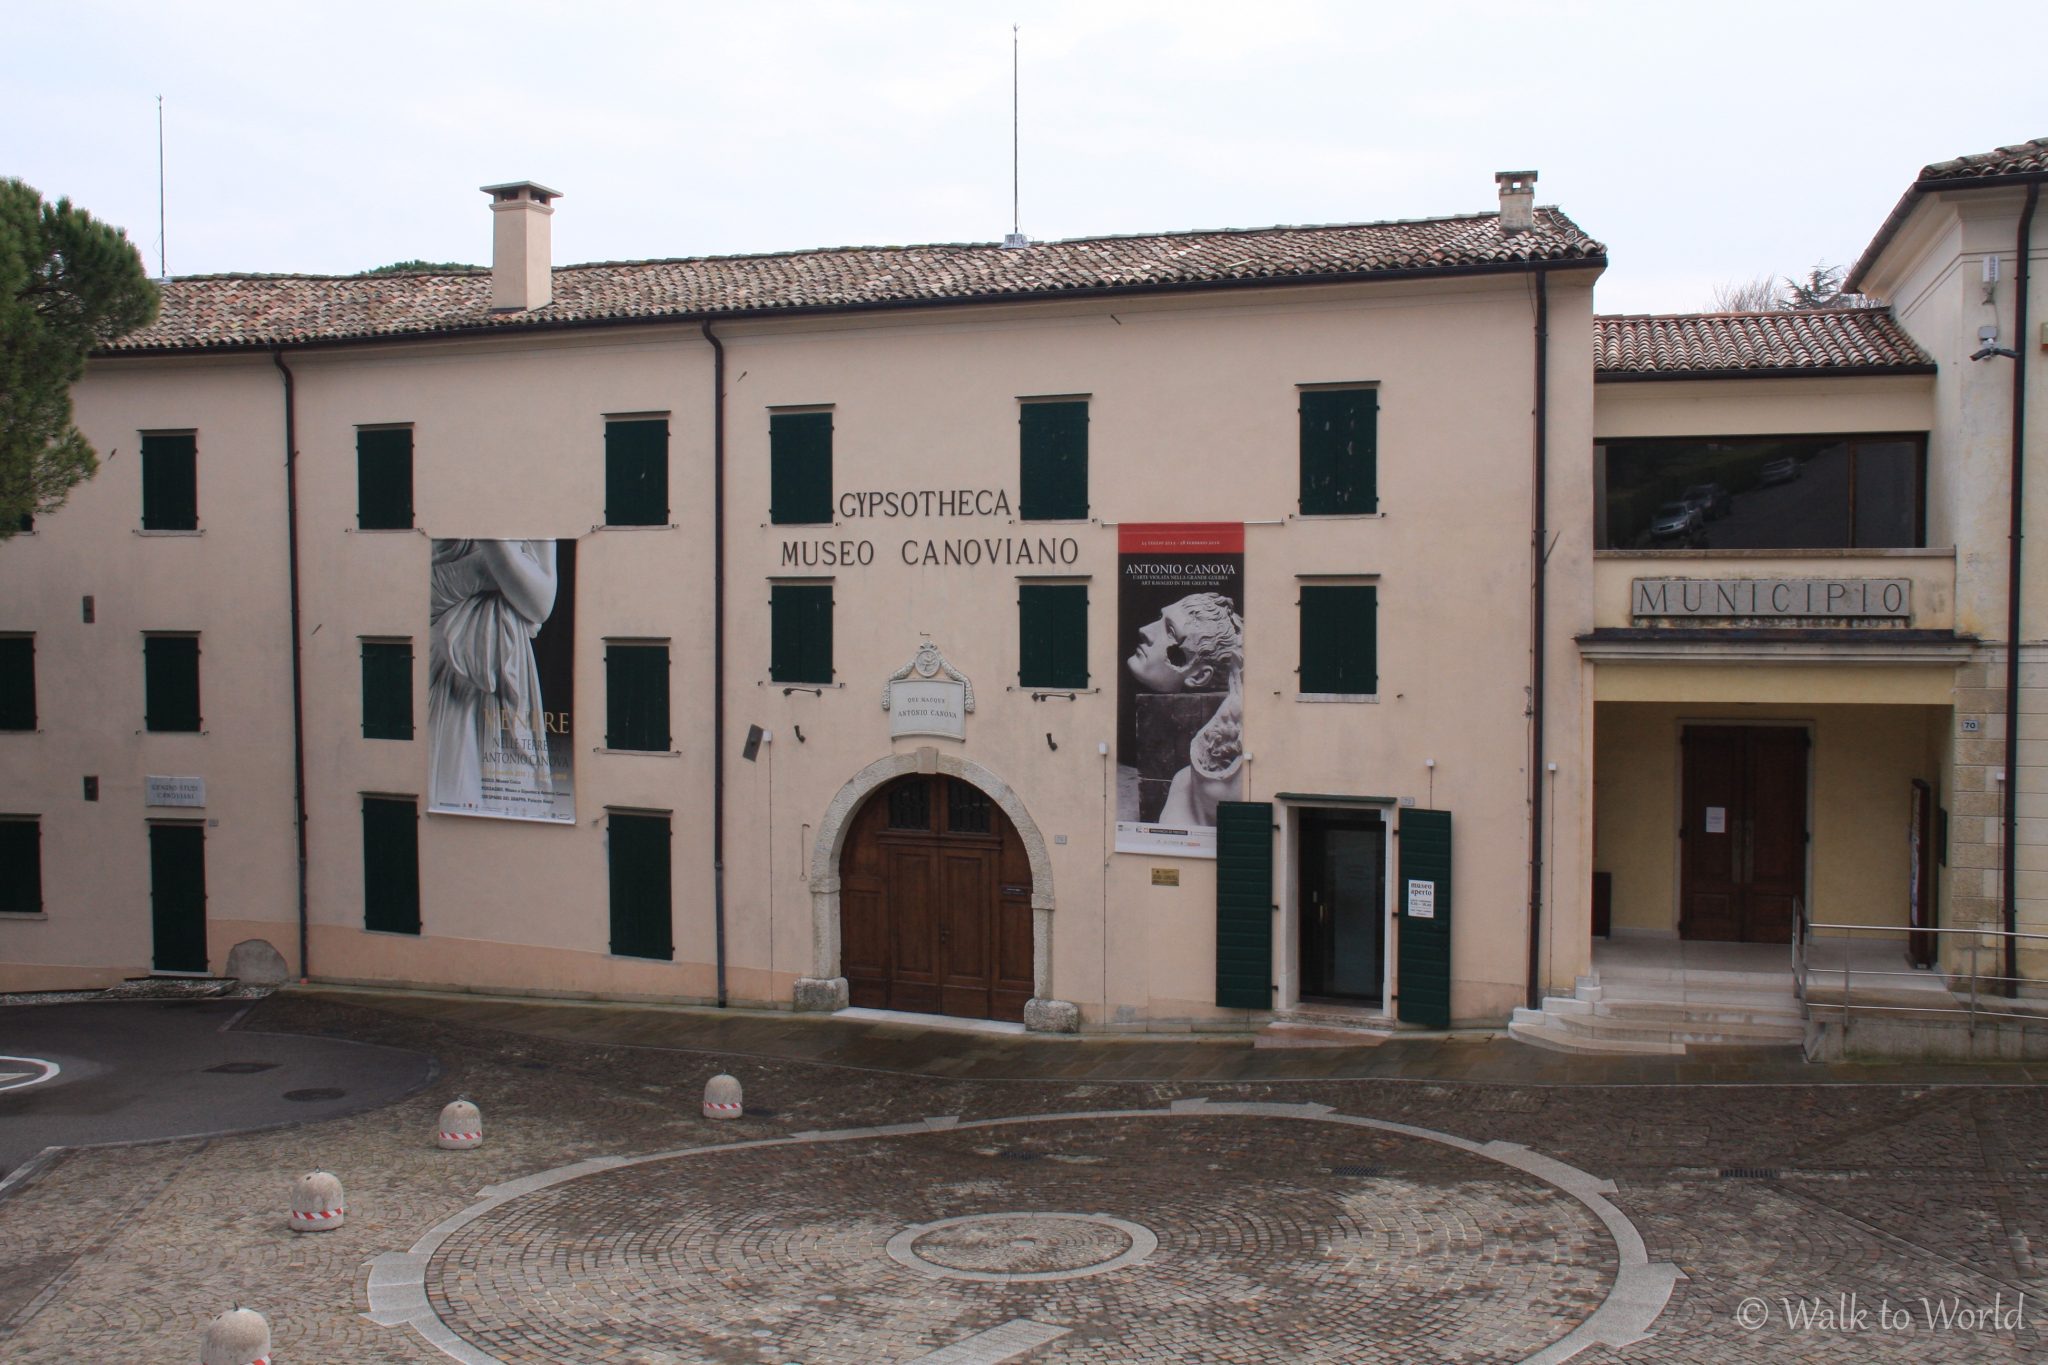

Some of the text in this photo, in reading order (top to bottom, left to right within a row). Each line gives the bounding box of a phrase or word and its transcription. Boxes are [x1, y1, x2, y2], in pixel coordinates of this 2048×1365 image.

[839, 489, 1012, 518] GYPSOTHECA
[781, 538, 1079, 567] MUSEO CANOVIANO
[1126, 564, 1236, 575] ANTONIO CANOVA
[1639, 583, 1902, 613] MUNICIPIO
[483, 708, 570, 734] VENRE
[898, 709, 957, 719] ANTONIO CANOVA
[481, 752, 569, 767] ANTONIO CANOVA
